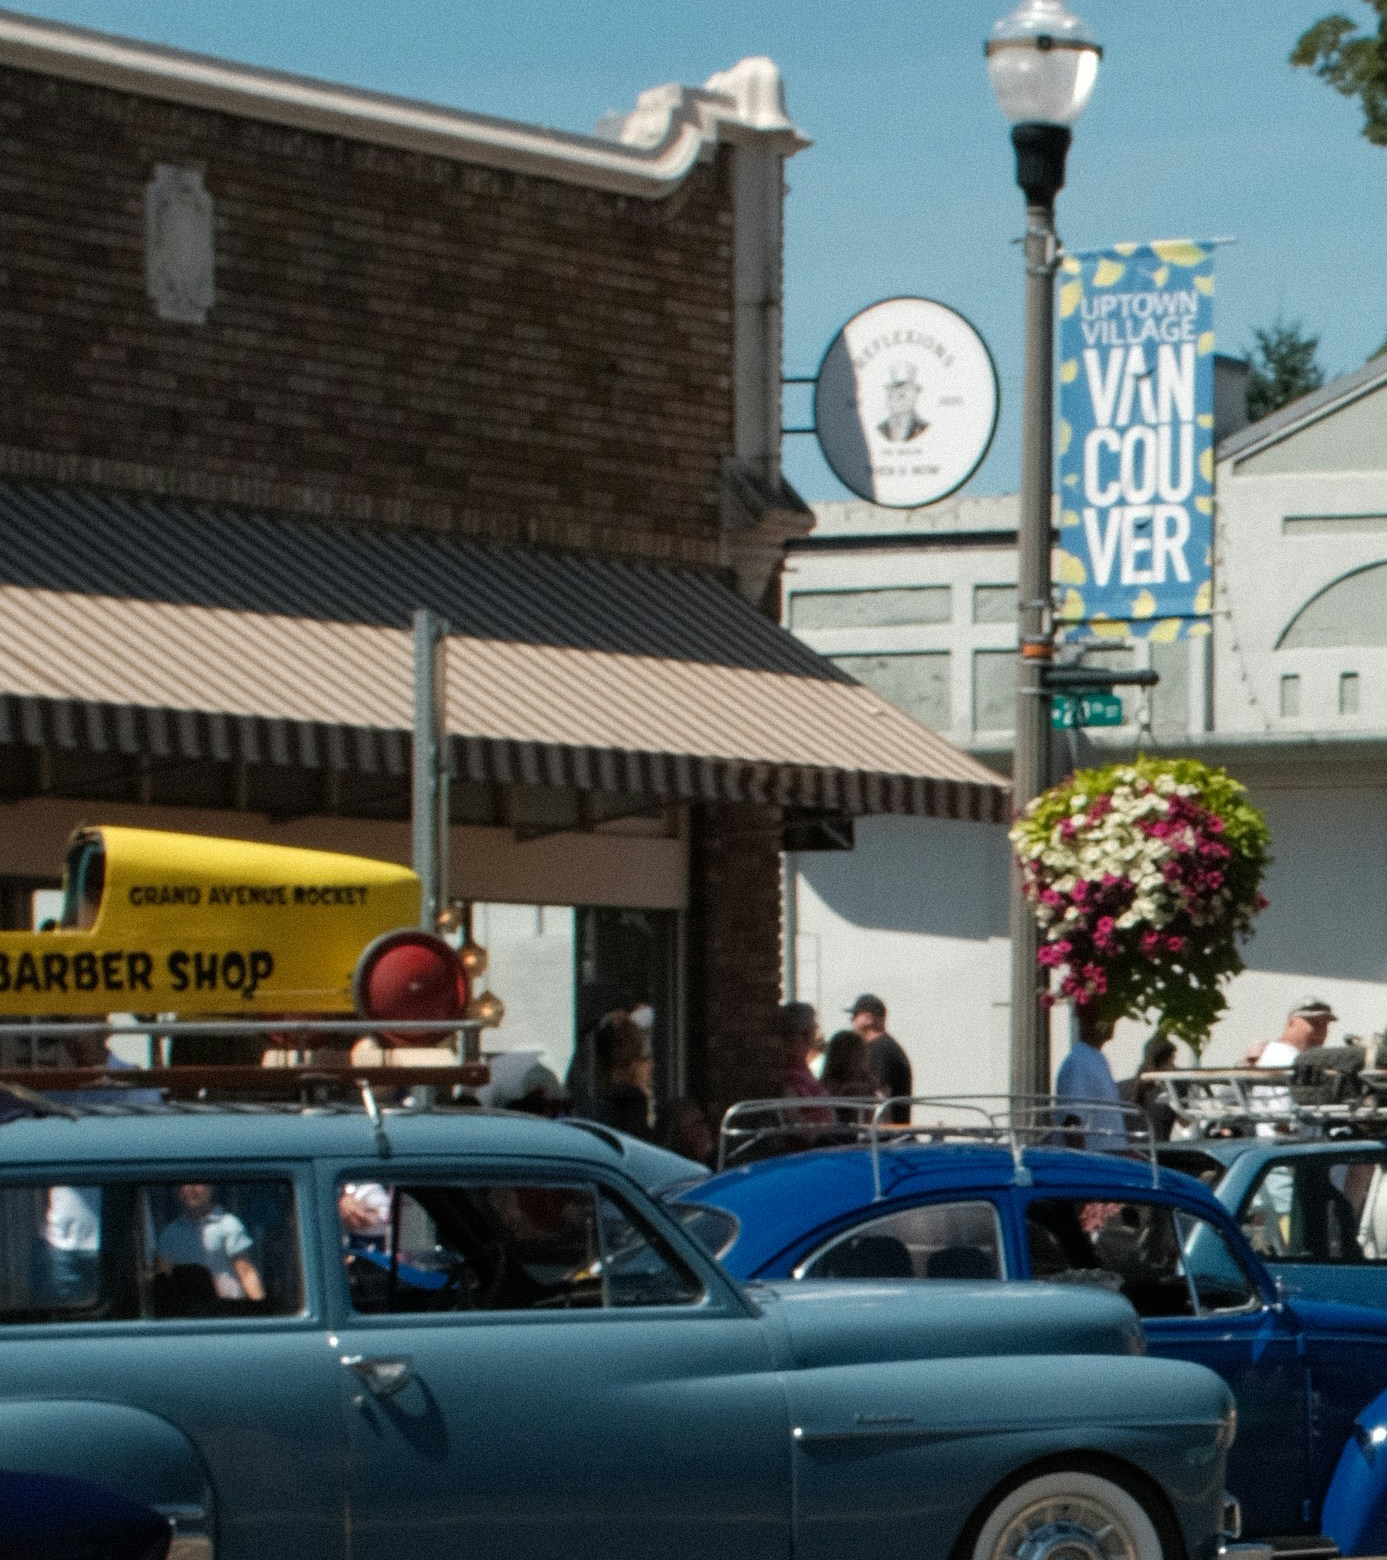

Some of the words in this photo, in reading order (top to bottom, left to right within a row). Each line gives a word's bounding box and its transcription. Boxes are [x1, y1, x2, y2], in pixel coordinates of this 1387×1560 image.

[1080, 290, 1198, 323] UPTOWN
[1081, 313, 1198, 345] VILLAGE
[1083, 344, 1195, 427] VAN
[1083, 425, 1195, 506] COU
[1083, 505, 1192, 586] VER
[128, 885, 201, 907] GRAND
[208, 885, 286, 907] AVENUE
[292, 886, 369, 907] ROCKET
[167, 949, 274, 1000] SHOP
